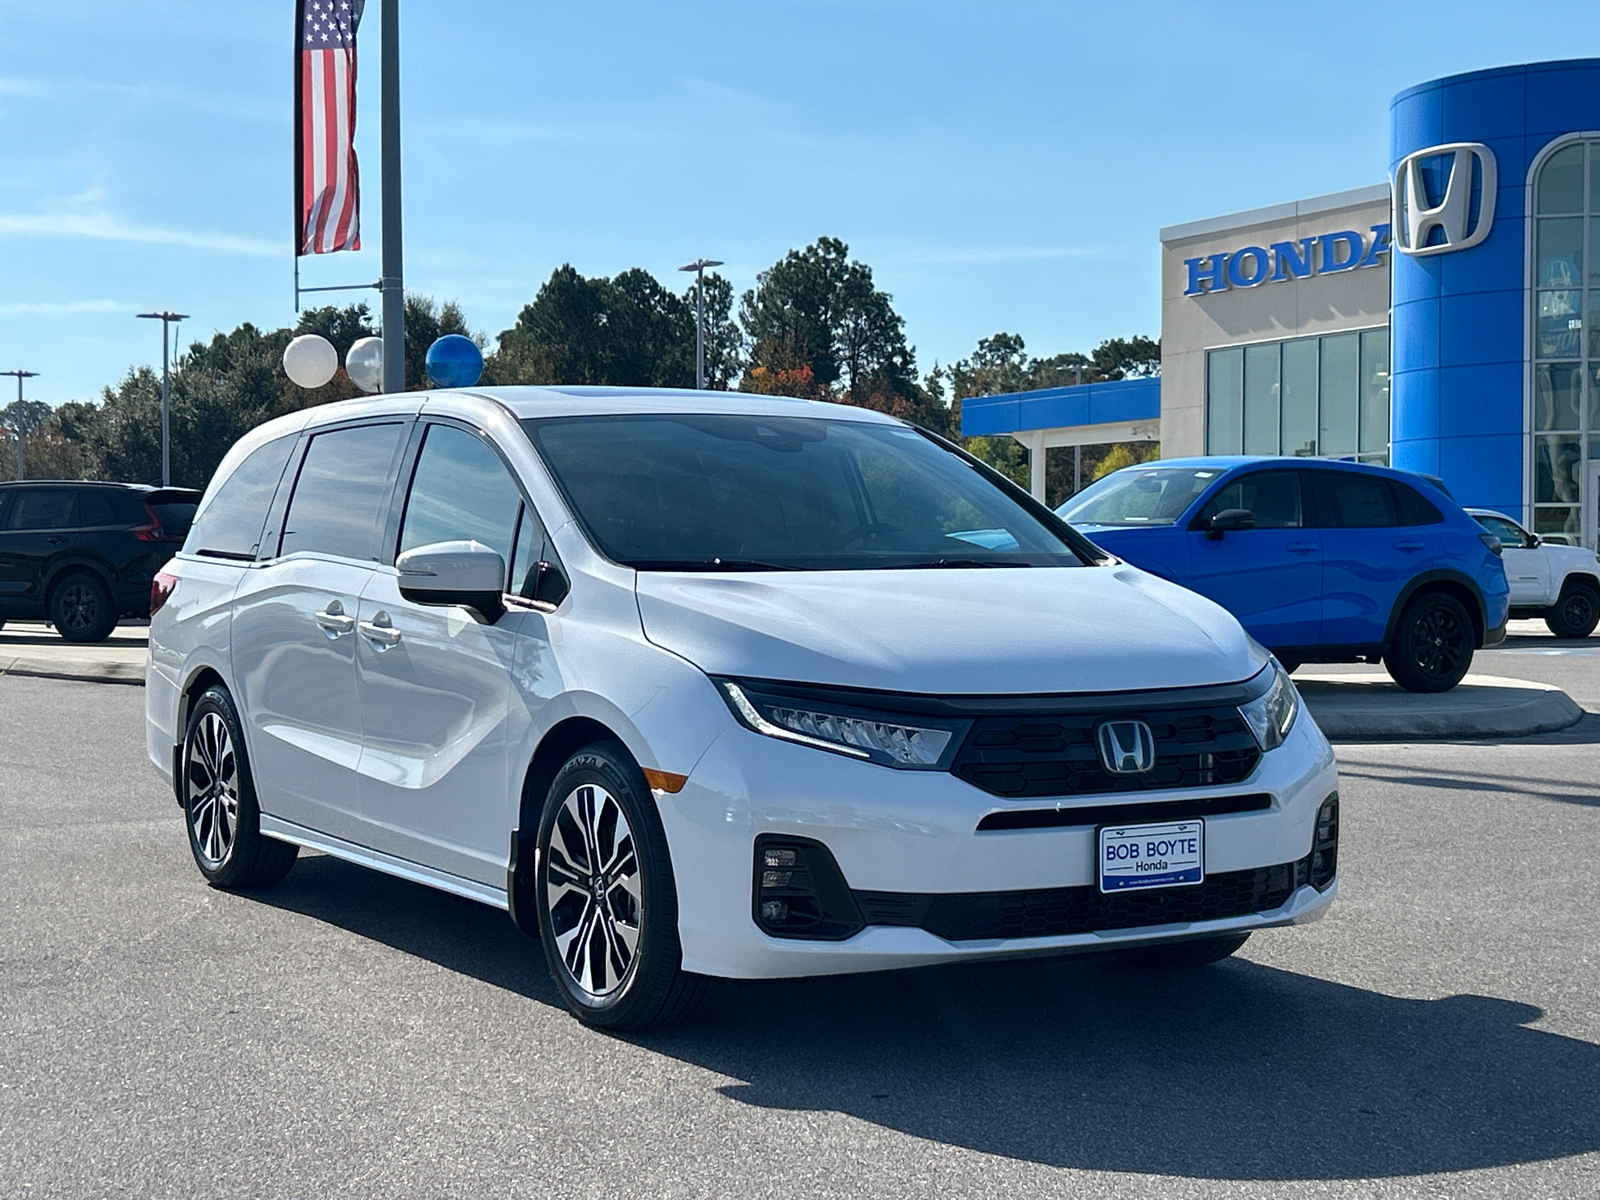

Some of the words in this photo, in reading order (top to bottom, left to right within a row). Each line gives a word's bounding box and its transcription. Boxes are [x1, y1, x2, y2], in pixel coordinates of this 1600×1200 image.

[1106, 843, 1140, 860] BOB
[1146, 838, 1197, 857] BOYTE
[1135, 860, 1168, 872] Honda
